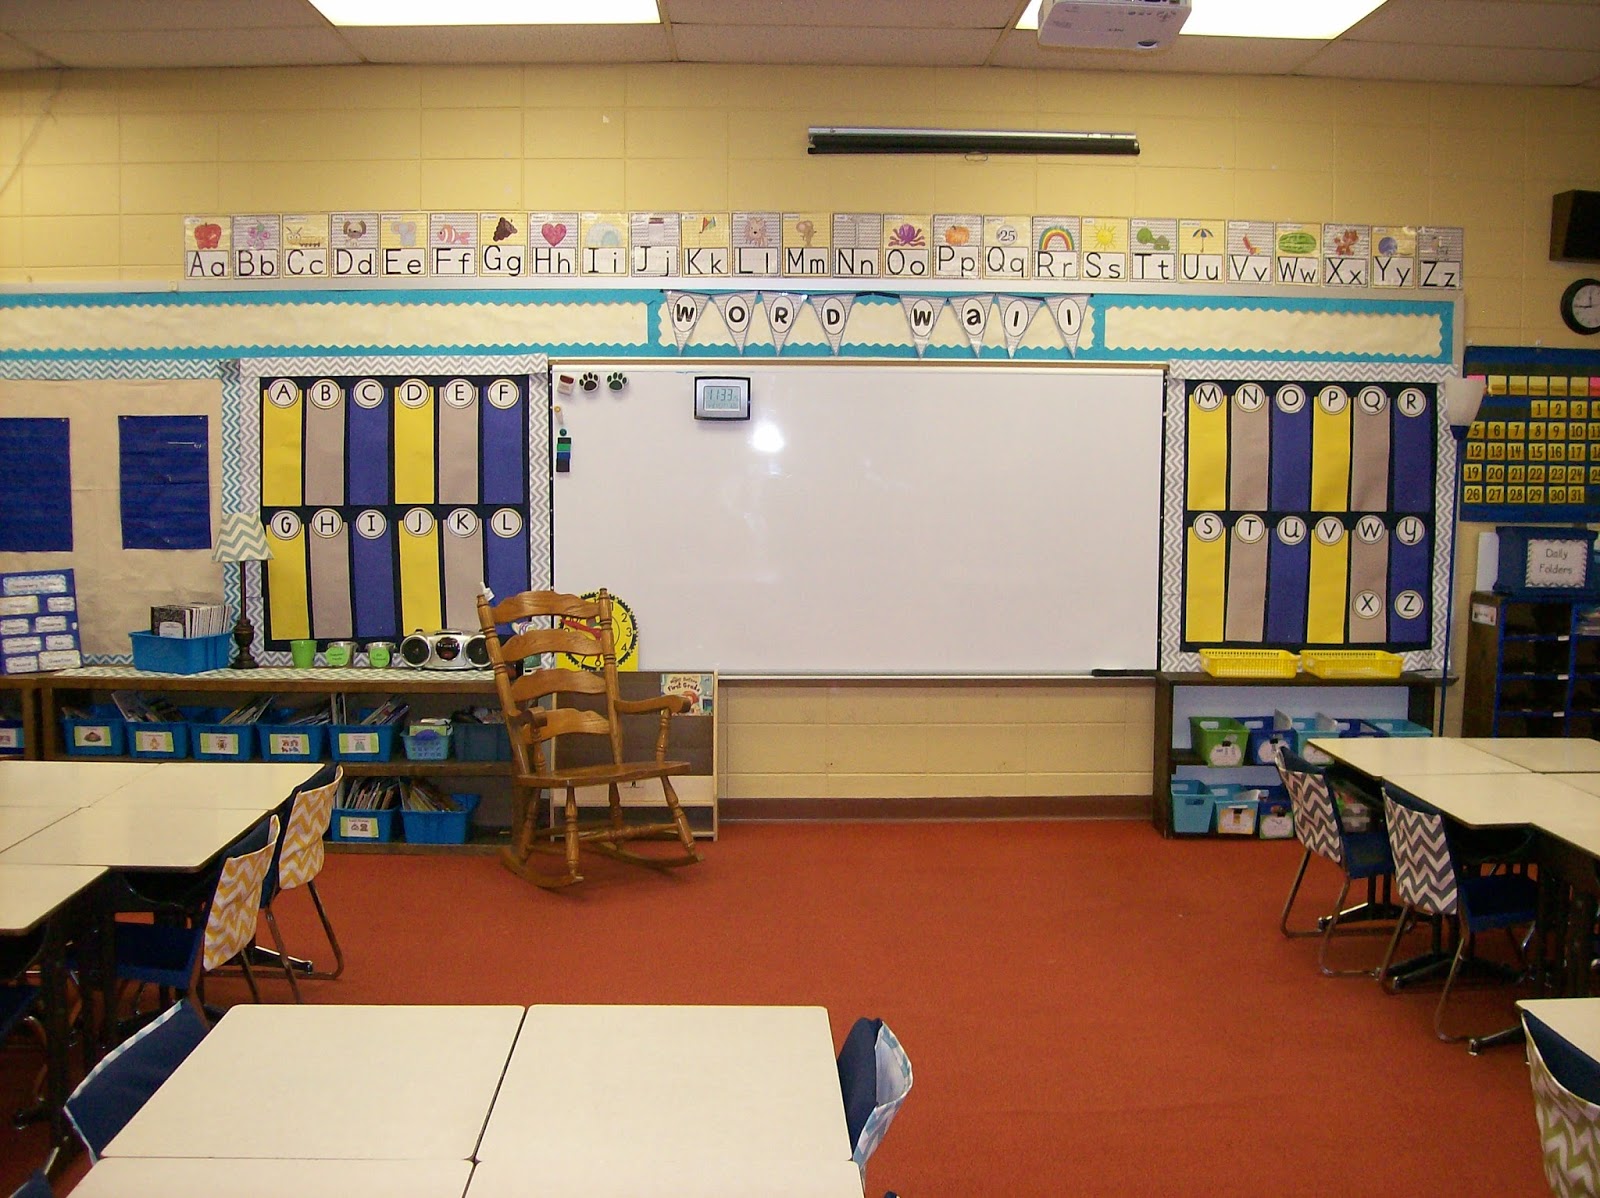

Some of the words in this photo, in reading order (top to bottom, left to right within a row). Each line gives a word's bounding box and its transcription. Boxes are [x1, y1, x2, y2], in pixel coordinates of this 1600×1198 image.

[1000, 230, 1015, 241] 25
[676, 304, 841, 326] WORD
[276, 384, 292, 400] A
[322, 385, 331, 400] B
[362, 384, 376, 400] C
[408, 385, 422, 400] D
[456, 384, 464, 400] E
[499, 384, 508, 400] F
[1198, 387, 1217, 404] M
[1243, 389, 1257, 405] N
[1283, 390, 1299, 406] O
[1328, 390, 1338, 406] P
[1364, 391, 1380, 411] Q
[1407, 394, 1416, 409] R
[1537, 404, 1541, 415] 1
[1556, 404, 1561, 415] 2
[1577, 404, 1582, 416] 3
[1474, 424, 1479, 436] 5
[1494, 425, 1500, 436] 6
[1514, 425, 1520, 435] 7
[1535, 425, 1541, 437] 8
[1553, 426, 1559, 437] 9
[1572, 426, 1582, 437] 10
[1470, 445, 1481, 457] 12
[1491, 446, 1502, 457] 13
[1511, 446, 1521, 457] 14
[1532, 446, 1543, 458] 15
[1550, 446, 1562, 458] 16
[1571, 447, 1581, 457] 17
[1467, 467, 1478, 478] 19
[1488, 468, 1503, 479] 20
[1512, 468, 1522, 480] 21
[1530, 468, 1543, 480] 22
[1552, 468, 1563, 480] 23
[1570, 469, 1582, 480] 24
[1467, 489, 1479, 500] 26
[1489, 489, 1502, 501] 27
[1510, 489, 1522, 501] 28
[1530, 489, 1542, 501] 29
[1551, 489, 1564, 501] 30
[1571, 489, 1581, 501] 31
[281, 516, 292, 534] G
[321, 516, 334, 532] H
[368, 516, 375, 532] I
[414, 515, 422, 532] J
[457, 514, 468, 529] K
[502, 514, 512, 530] L
[1203, 518, 1212, 535] S
[1244, 519, 1257, 535] T
[1323, 523, 1336, 539] V
[1362, 522, 1380, 537] W
[1546, 548, 1568, 559] Daily
[1539, 564, 1572, 574] Folders
[1362, 596, 1373, 612] X
[1403, 596, 1414, 611] Z
[621, 613, 627, 622] 2
[626, 627, 632, 637] 3
[621, 643, 627, 651] 4
